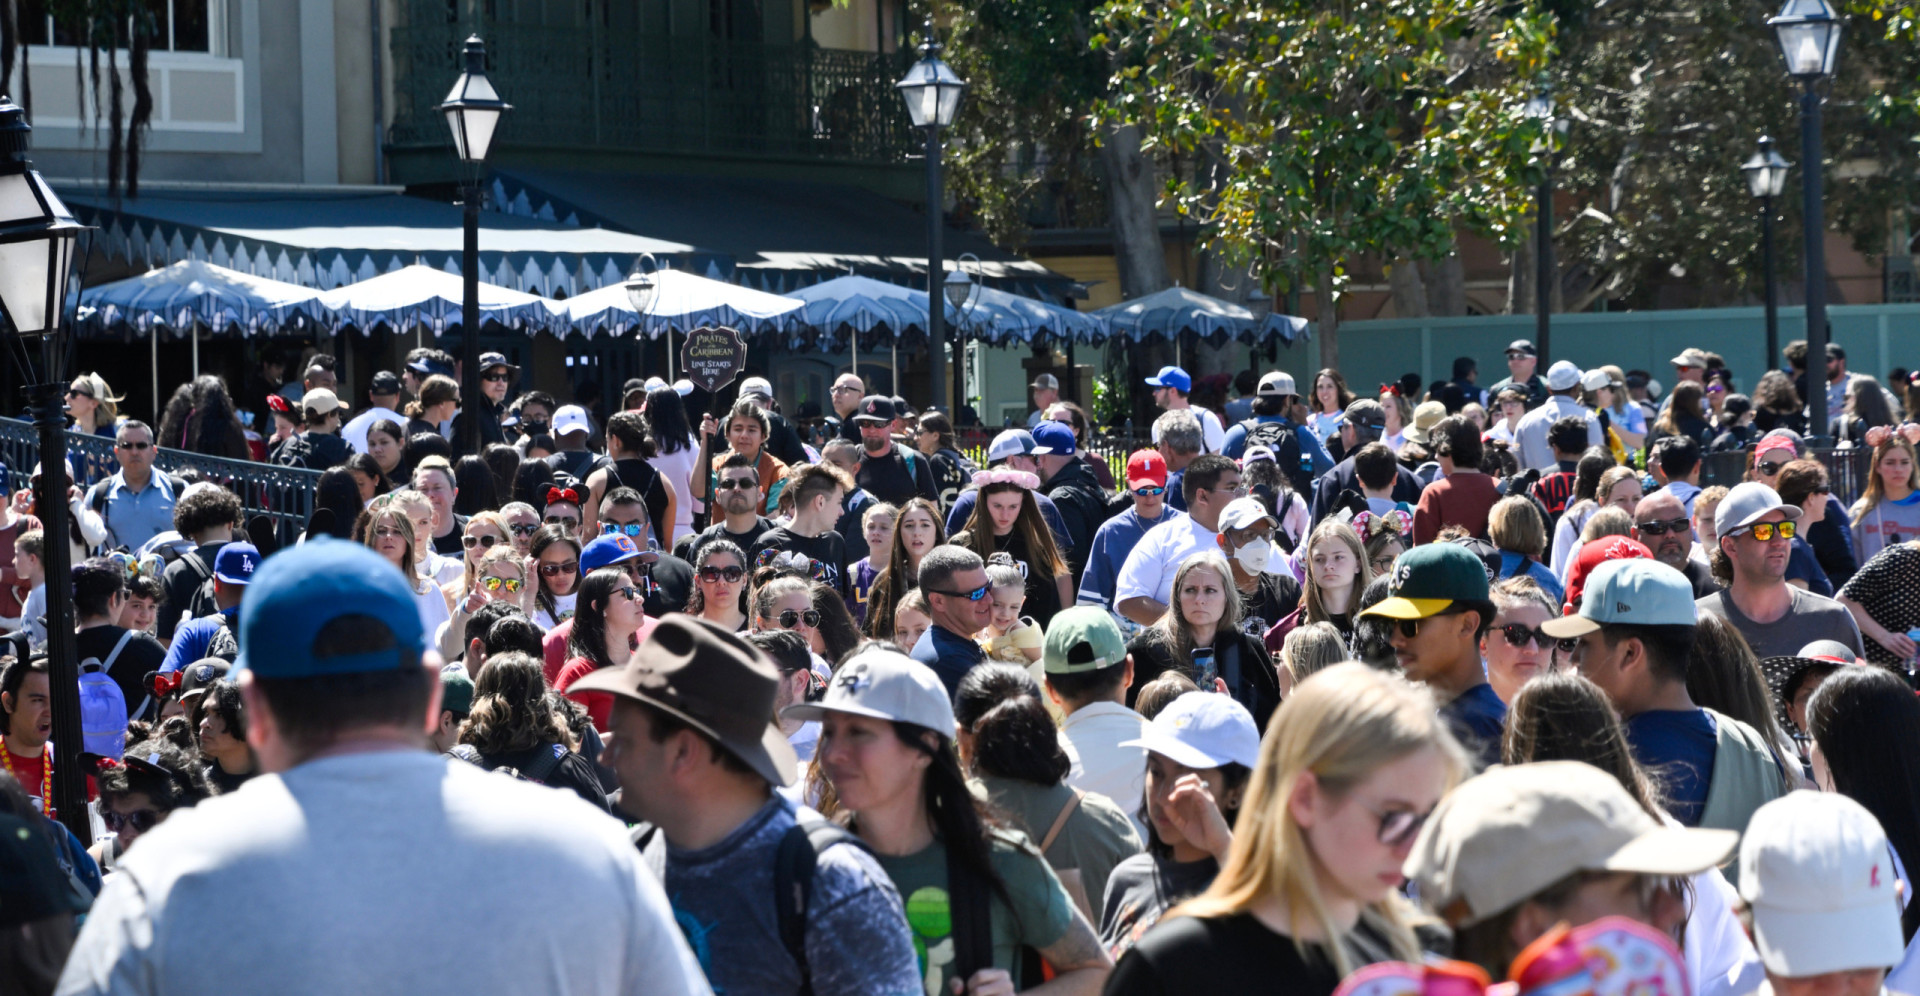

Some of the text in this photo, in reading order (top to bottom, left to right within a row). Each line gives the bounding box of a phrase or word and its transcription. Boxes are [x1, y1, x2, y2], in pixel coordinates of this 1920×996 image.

[696, 334, 728, 346] PIRATES
[689, 345, 734, 358] CARIBBEAN
[691, 360, 732, 369] LINE STARTS
[702, 367, 720, 376] HERE
[242, 554, 254, 572] LA
